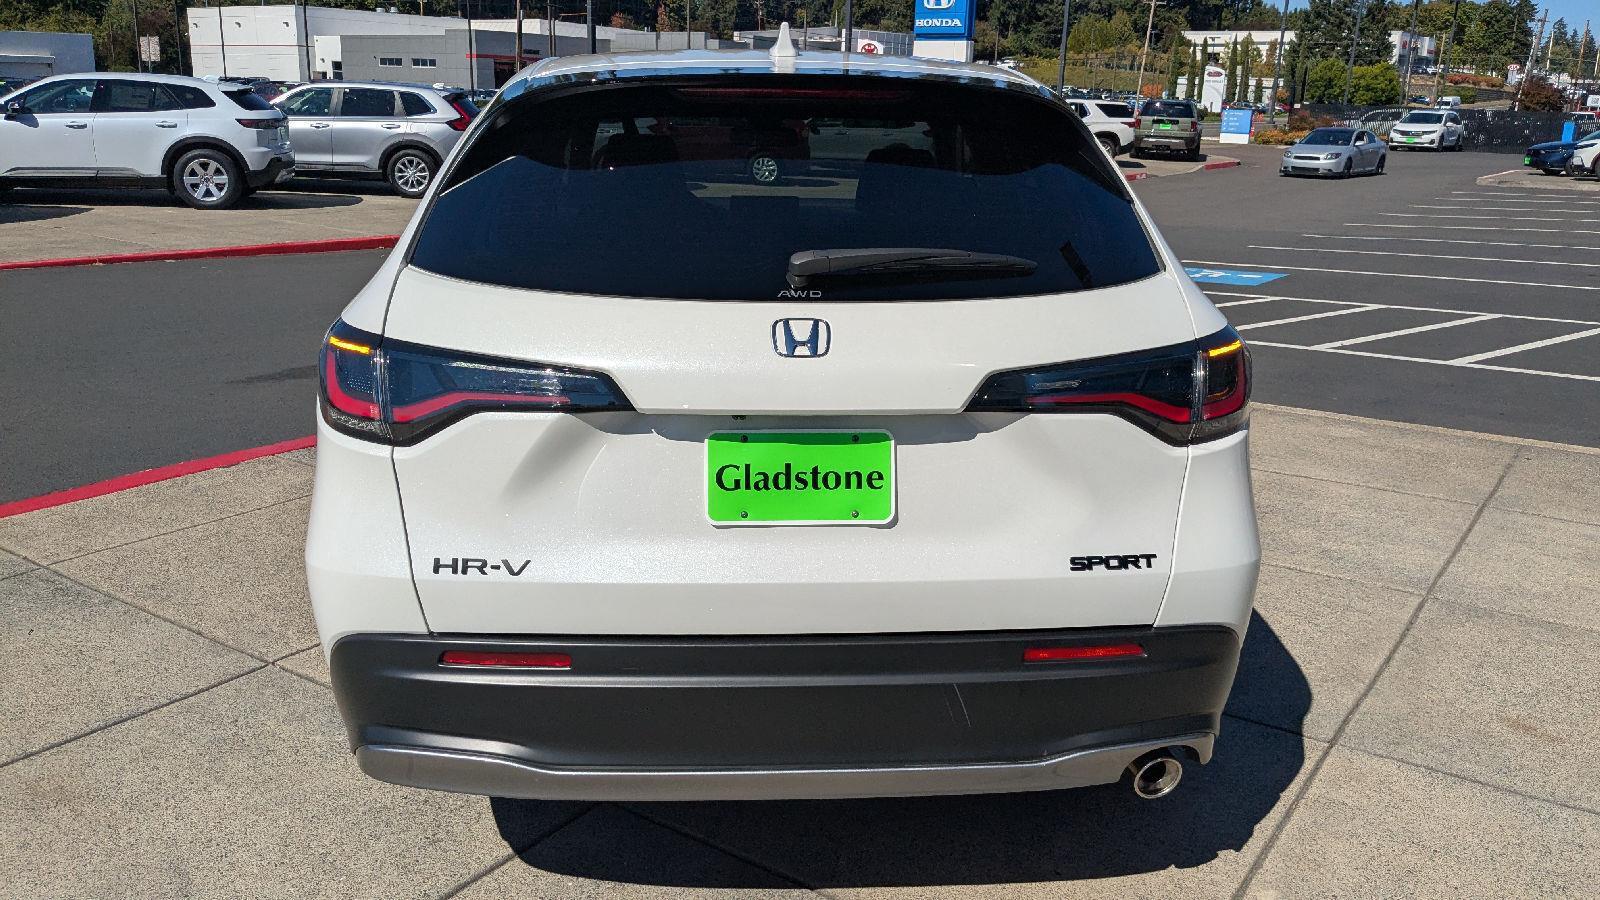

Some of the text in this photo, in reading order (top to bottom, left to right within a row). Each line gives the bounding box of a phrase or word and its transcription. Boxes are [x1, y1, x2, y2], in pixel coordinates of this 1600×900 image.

[915, 18, 962, 27] HONDA
[777, 289, 822, 298] AWD
[715, 462, 884, 492] Gladstone
[432, 557, 532, 577] HR-V
[1069, 553, 1158, 572] SPORT
